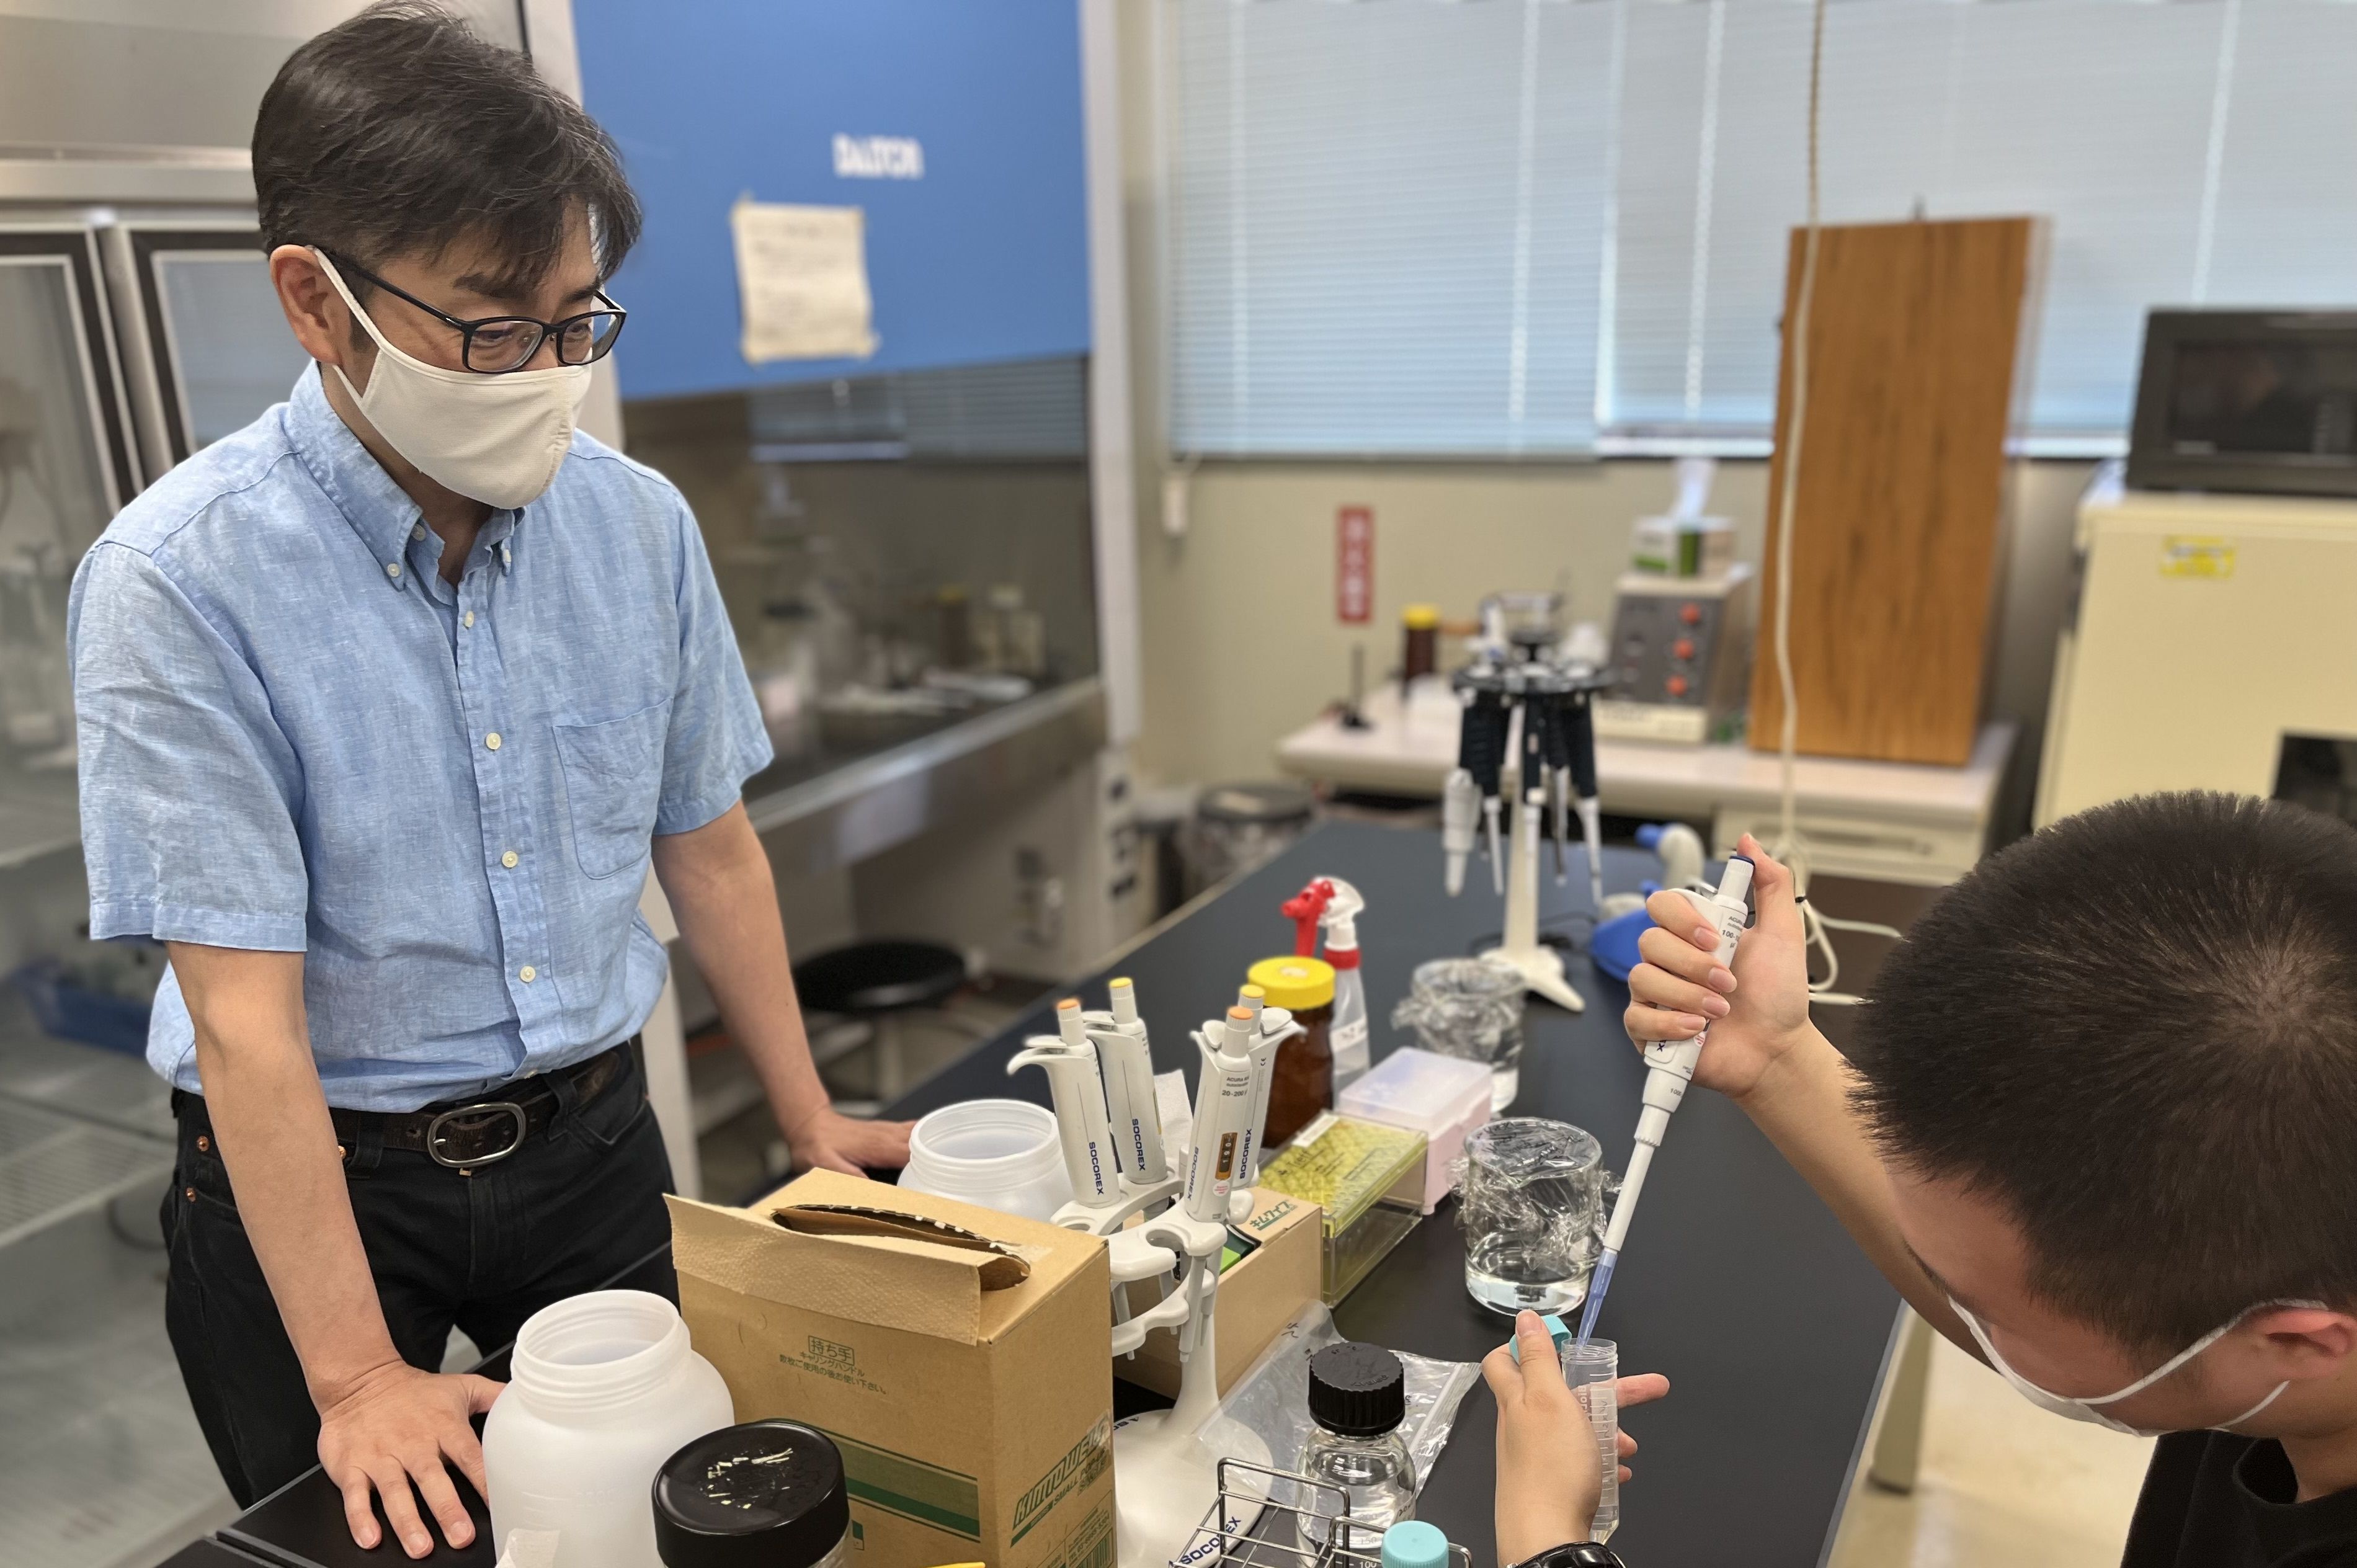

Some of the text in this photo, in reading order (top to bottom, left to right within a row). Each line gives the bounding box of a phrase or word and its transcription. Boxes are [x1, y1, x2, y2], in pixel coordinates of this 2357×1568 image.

[1089, 1141, 1104, 1195] SOCOREX
[1132, 1118, 1146, 1171] SOCOREX
[1239, 1128, 1252, 1179] SOCOREX
[1187, 1146, 1199, 1201] SOCOREX
[800, 1351, 865, 1377] キャリングハンドル
[811, 1339, 852, 1361] 持ち手
[1054, 1476, 1079, 1506] SMALL
[1180, 1516, 1241, 1564] SOCOEX
